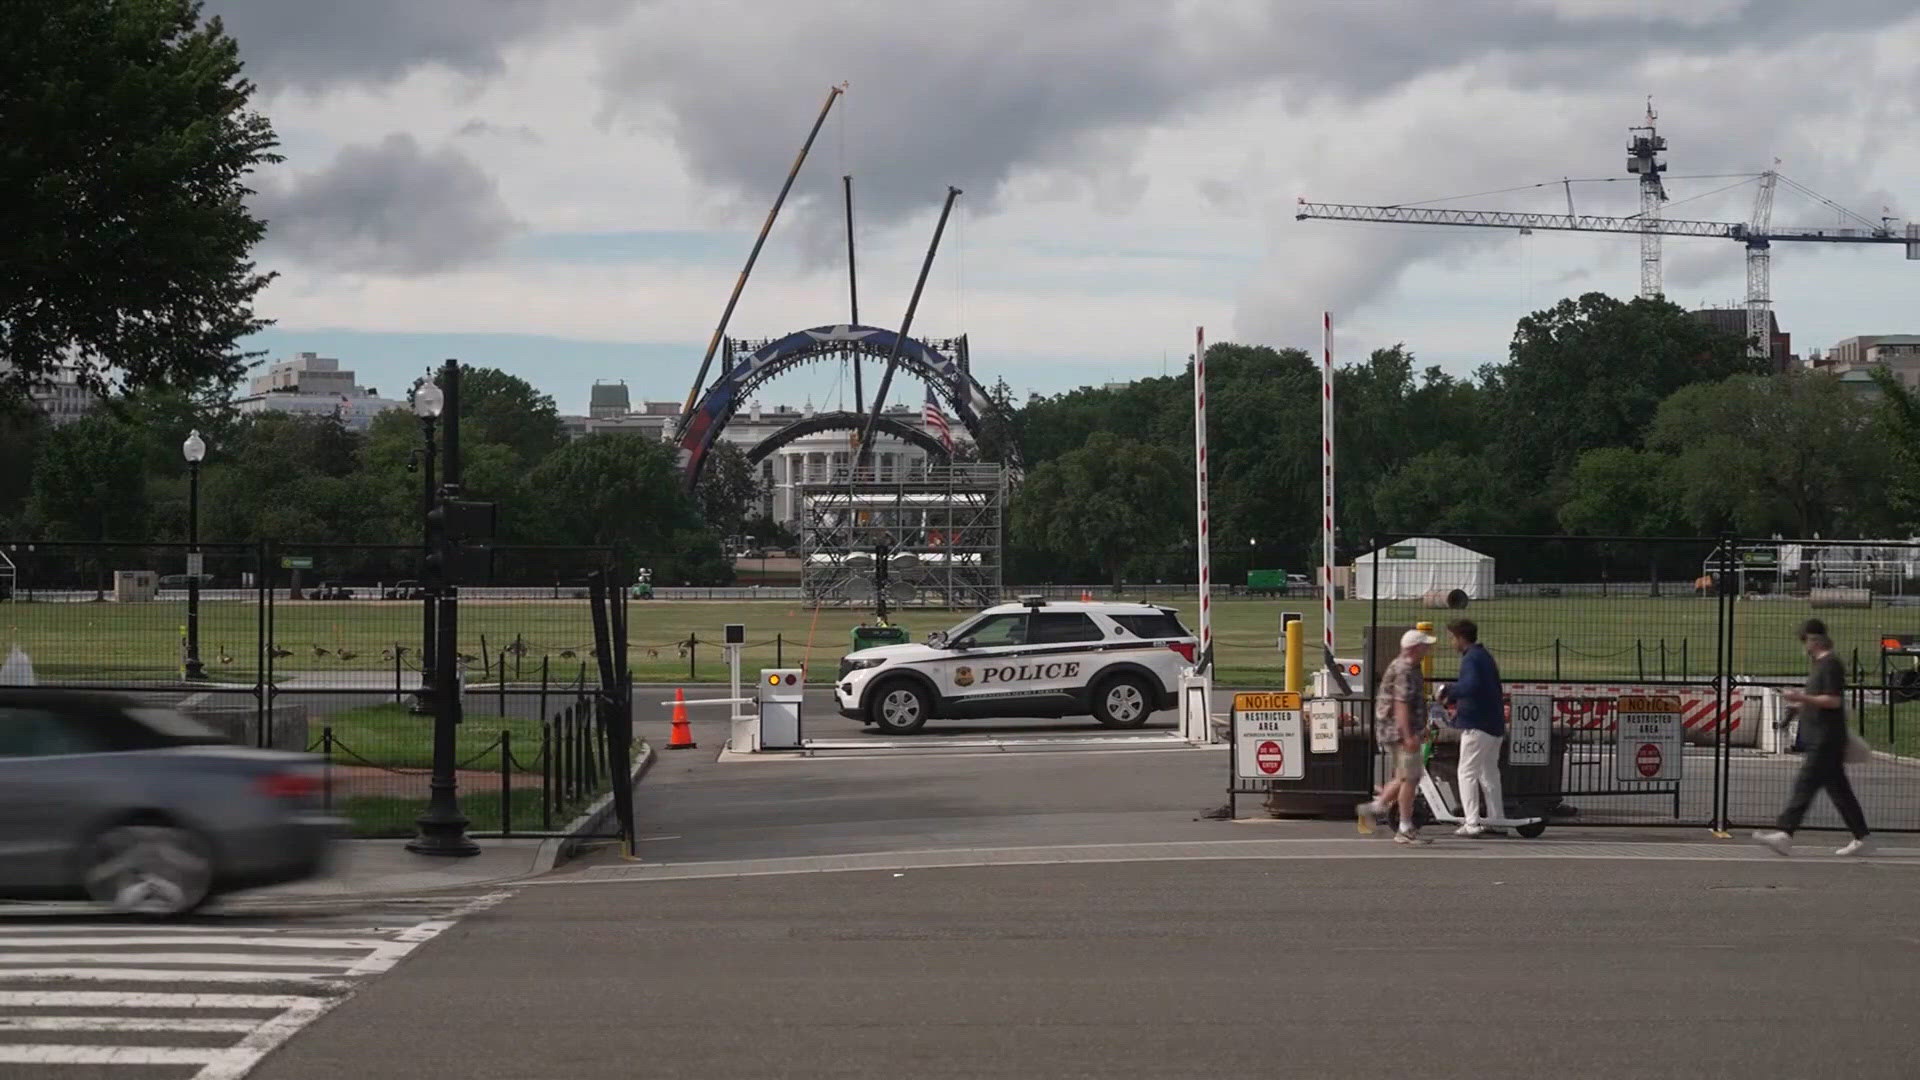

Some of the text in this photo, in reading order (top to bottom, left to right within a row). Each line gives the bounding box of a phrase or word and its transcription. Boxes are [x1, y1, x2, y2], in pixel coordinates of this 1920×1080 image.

[980, 661, 1080, 683] POLICE
[1245, 696, 1290, 709] NOTICE
[1629, 698, 1670, 711] NOTICE
[1245, 712, 1292, 721] RESTRICTED
[1627, 715, 1672, 724] RESTRICTED
[1258, 722, 1279, 731] AREA
[1524, 726, 1535, 737] ID
[1639, 725, 1659, 733] AREA
[1512, 741, 1545, 754] CHECK
